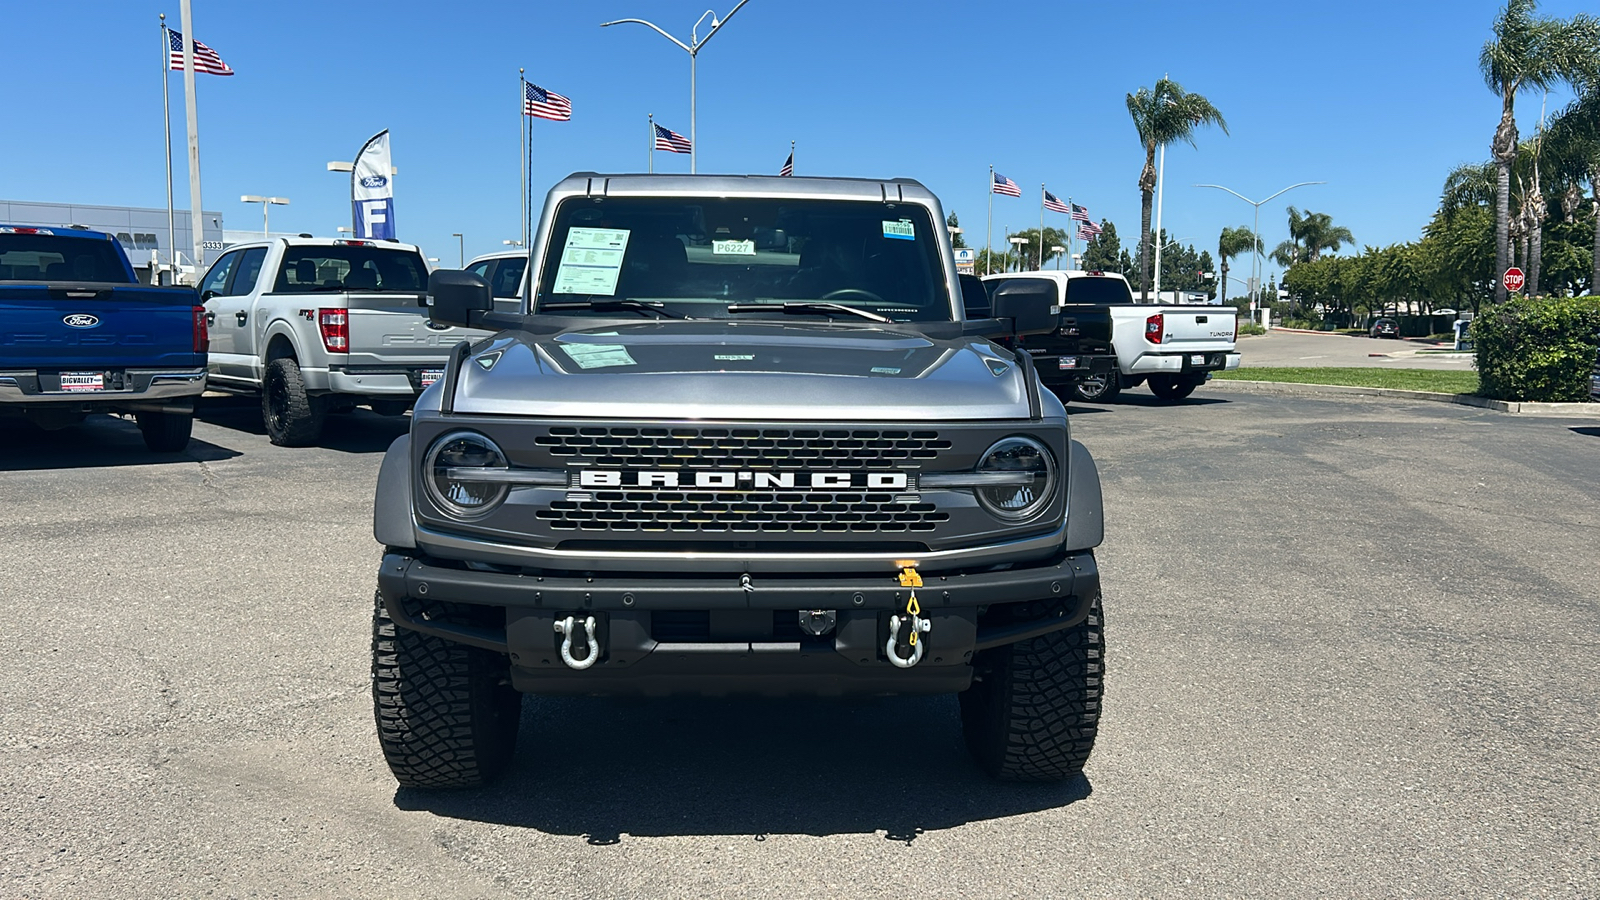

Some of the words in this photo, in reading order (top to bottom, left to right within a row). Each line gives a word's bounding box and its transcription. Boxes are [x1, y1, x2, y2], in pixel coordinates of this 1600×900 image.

[363, 177, 385, 188] Ford
[363, 201, 387, 238] F
[117, 233, 159, 250] AM
[717, 243, 749, 253] P6227
[1505, 275, 1523, 285] STOP
[67, 315, 95, 326] Ford
[580, 470, 908, 488] BRONCO
